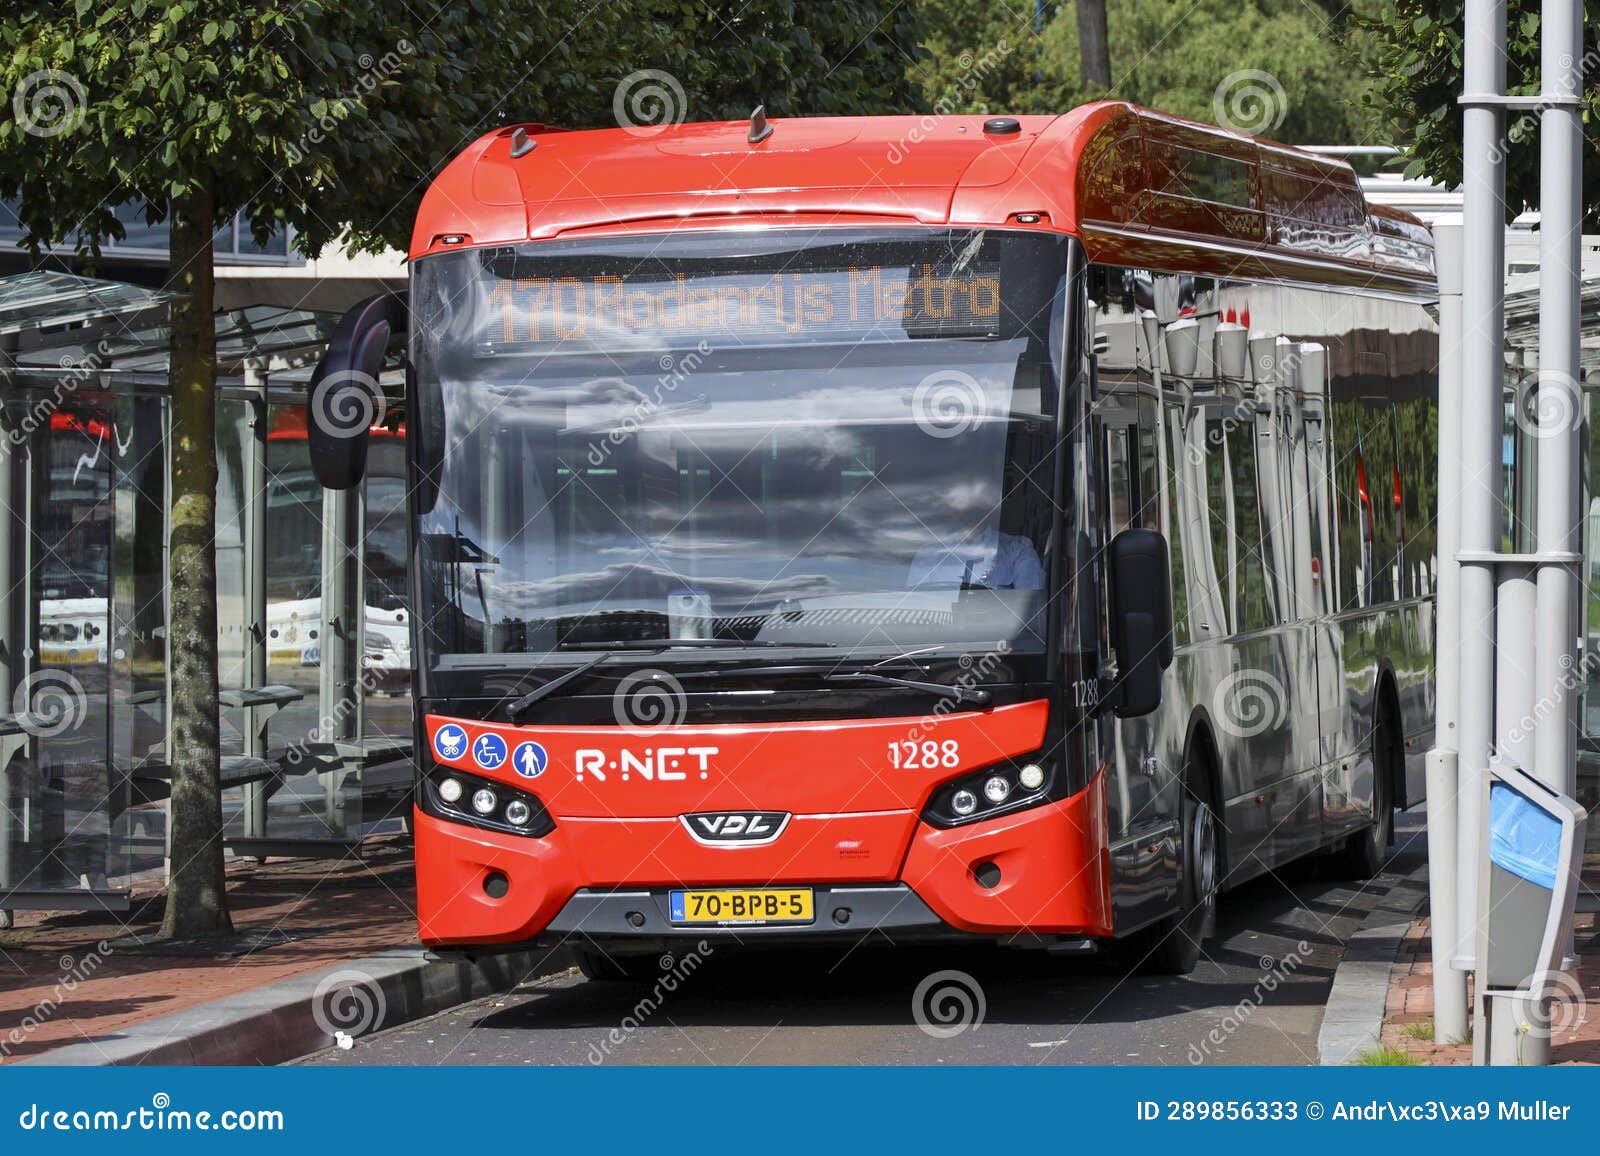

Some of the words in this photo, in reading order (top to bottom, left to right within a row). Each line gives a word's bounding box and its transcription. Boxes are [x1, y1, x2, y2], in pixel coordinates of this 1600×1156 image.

[488, 276, 586, 343] 170
[594, 272, 834, 333] Rodenrijs
[848, 263, 999, 321] Metro
[1072, 678, 1099, 707] 1288
[888, 739, 960, 769] 1288
[698, 815, 770, 834] VDL
[691, 894, 803, 916] 70-BPB-5
